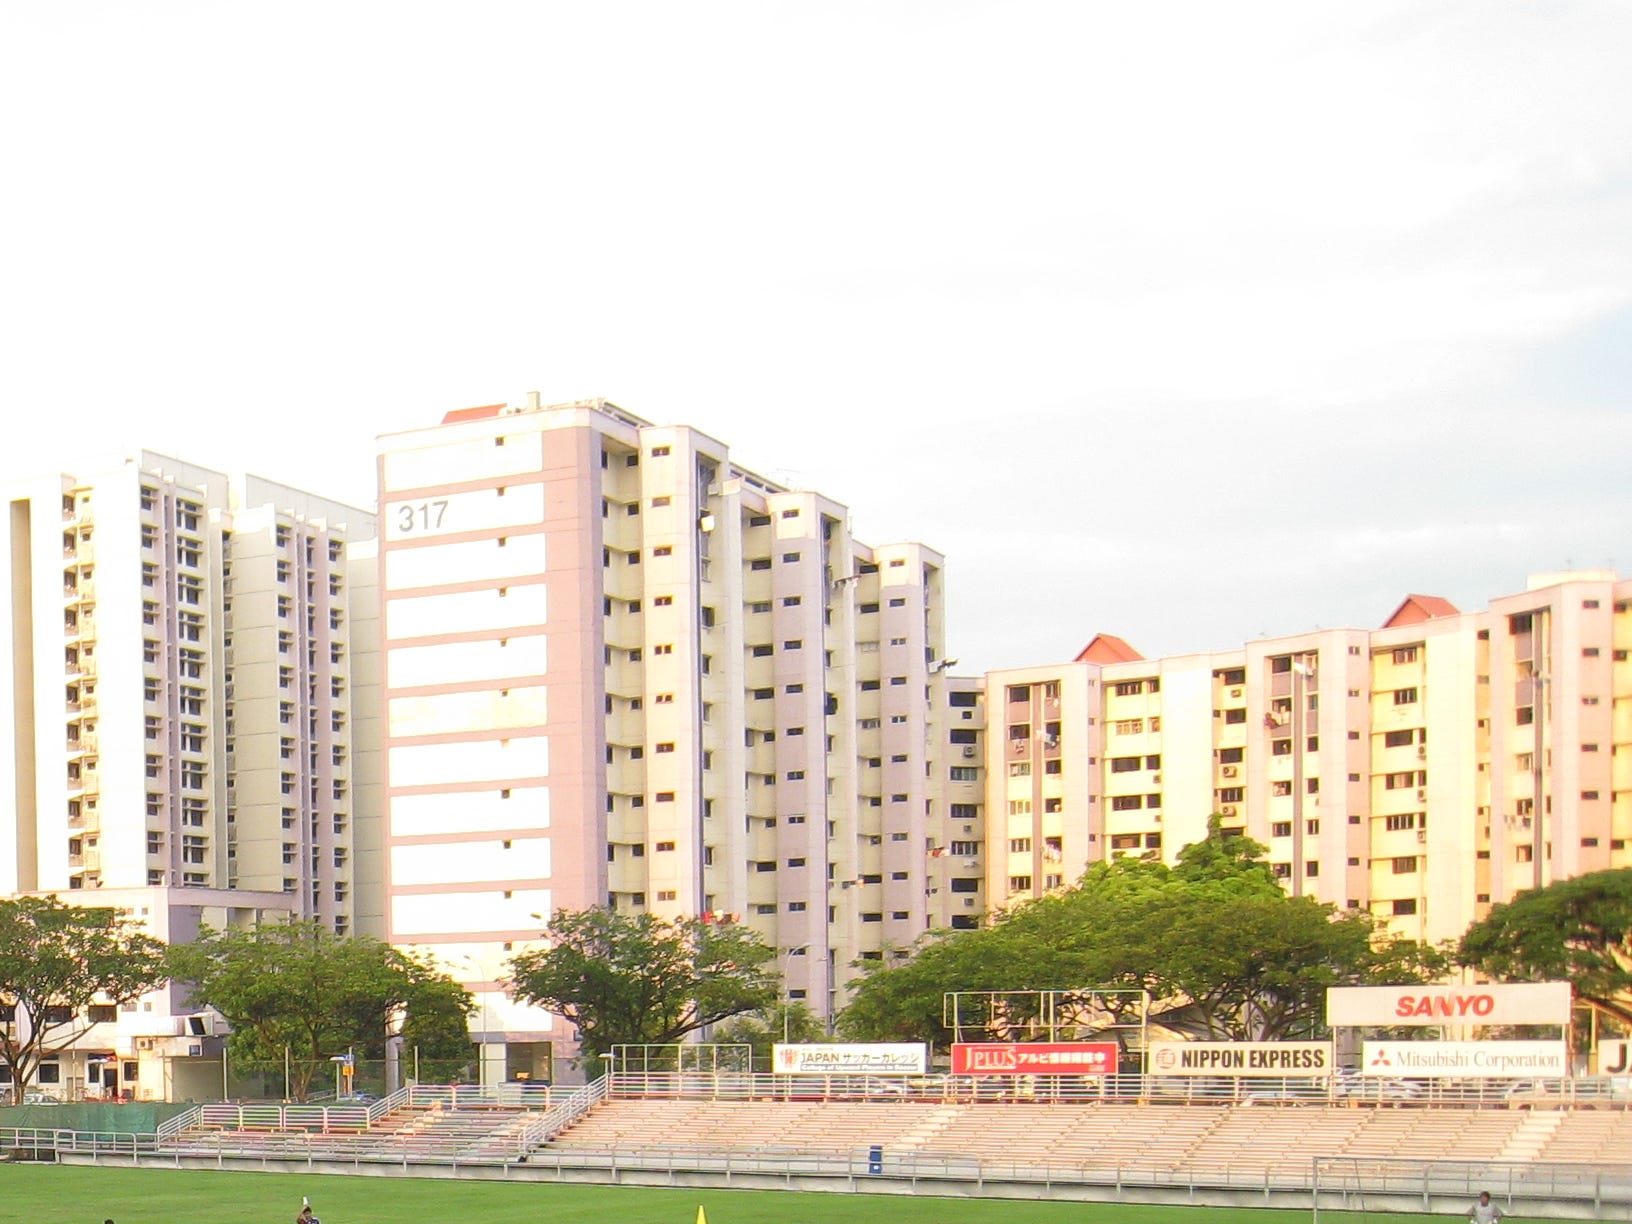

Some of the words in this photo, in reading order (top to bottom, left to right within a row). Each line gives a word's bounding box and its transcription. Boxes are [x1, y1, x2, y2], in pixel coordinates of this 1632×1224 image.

[398, 500, 448, 532] 317
[1394, 992, 1495, 1018] SANYO
[800, 1053, 840, 1063] JAPAN
[1181, 1049, 1244, 1068] NIPPON
[1249, 1049, 1325, 1068] EXPRESS
[1396, 1051, 1469, 1068] Mitsubishi
[1474, 1051, 1559, 1071] Corporation
[1606, 1044, 1632, 1073] J
